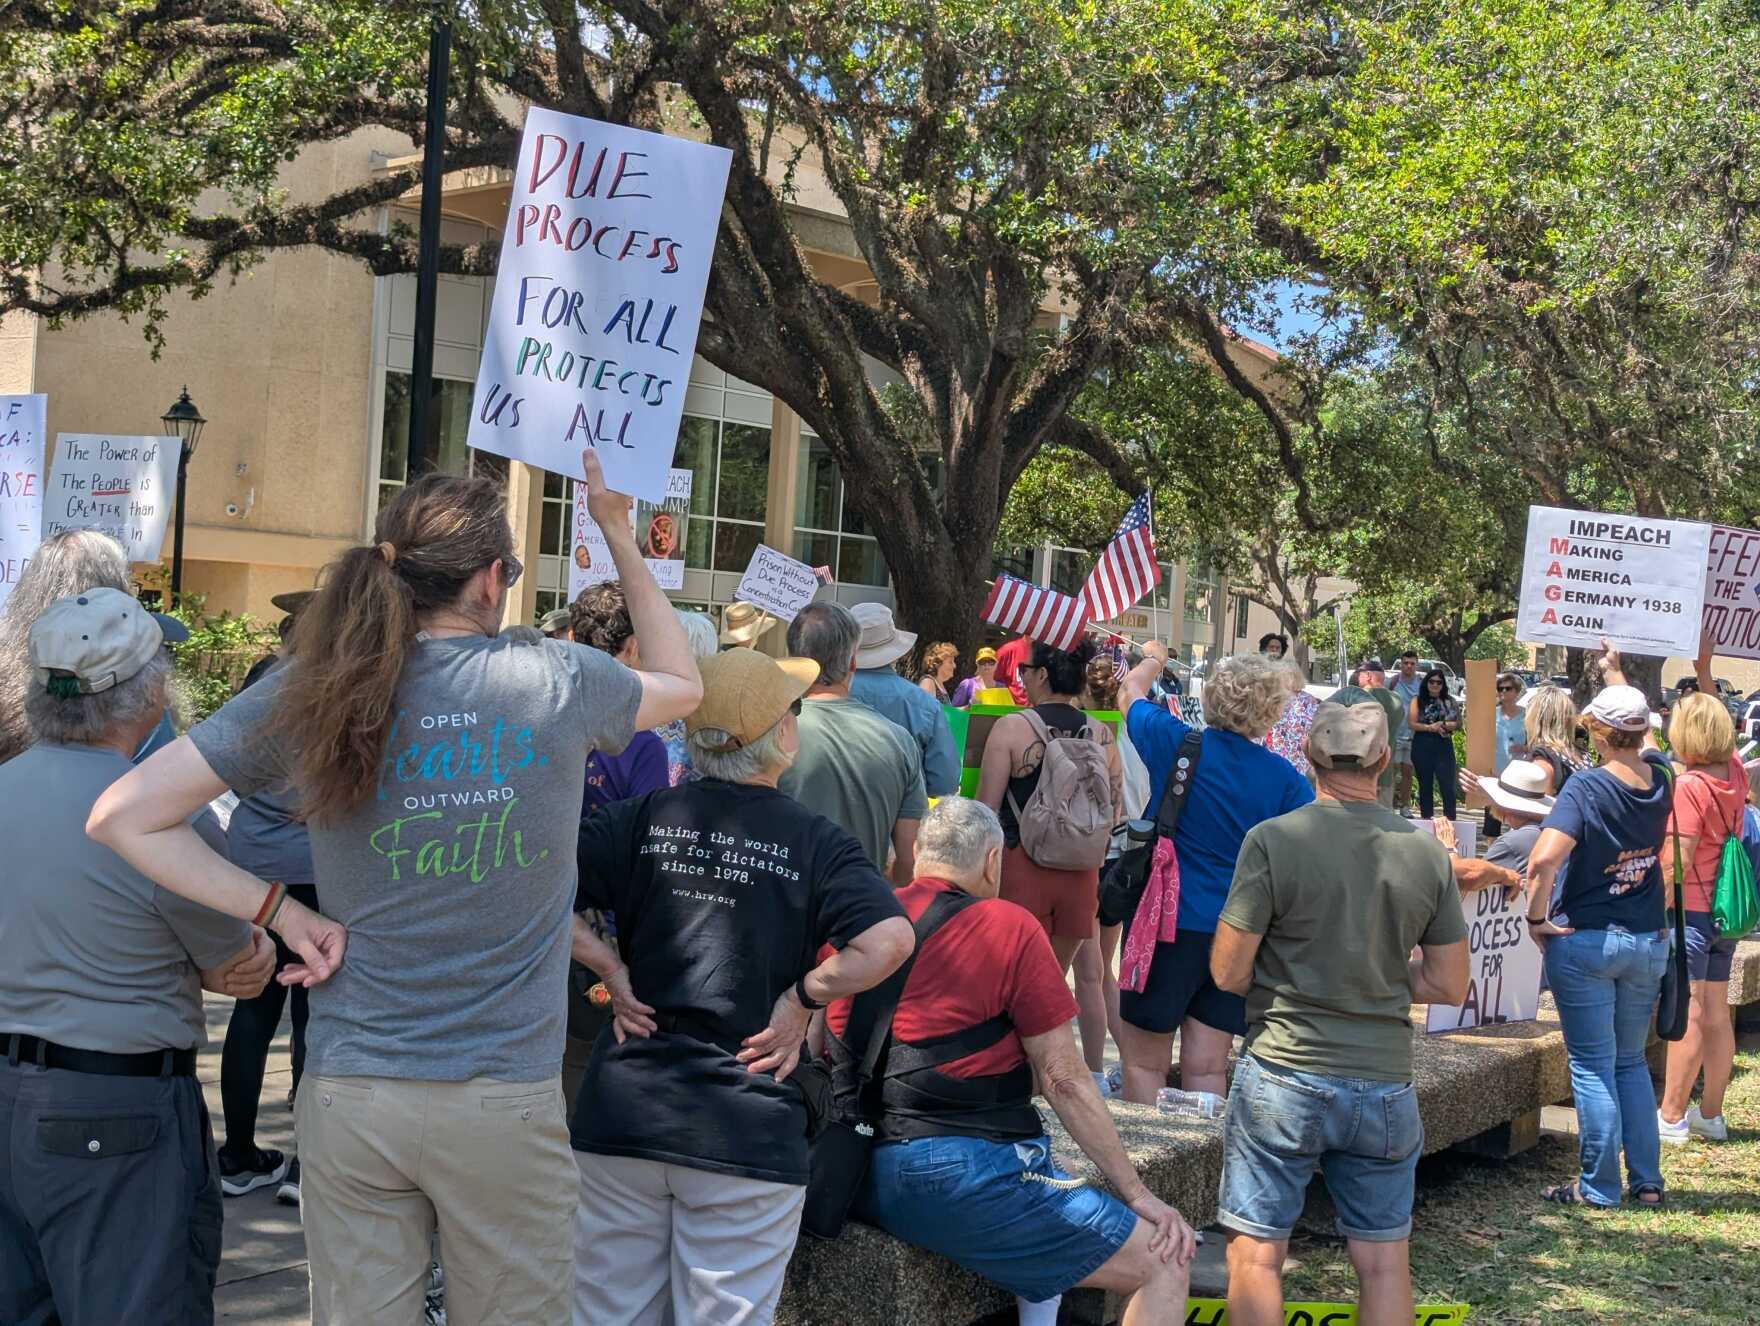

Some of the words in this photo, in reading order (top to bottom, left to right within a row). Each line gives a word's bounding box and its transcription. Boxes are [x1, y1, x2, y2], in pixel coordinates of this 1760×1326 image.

[528, 133, 652, 200] DUE
[515, 203, 682, 274] PROCESS
[515, 276, 588, 336] FOR
[603, 299, 680, 355] ALL
[515, 336, 673, 407] PROTECTS
[480, 383, 525, 428] US
[564, 403, 636, 449] ALL
[65, 440, 89, 461] The
[143, 442, 159, 462] of
[0, 471, 37, 497] RSE
[61, 473, 86, 490] The
[668, 475, 691, 494] ACH
[67, 495, 121, 518] GREATER
[129, 502, 154, 517] than
[1569, 519, 1672, 545] IMPEACH
[1550, 538, 1624, 561] MAKING
[758, 553, 782, 574] Prison
[1546, 560, 1632, 586] AMERICA
[758, 568, 776, 585] Due
[779, 577, 810, 599] Process
[1714, 580, 1745, 600] THE
[1545, 585, 1637, 609] GERMANY
[1642, 598, 1682, 614] 1938
[1541, 607, 1604, 630] AGAIN
[420, 711, 478, 729] OPEN
[404, 787, 515, 809] OUTWARD
[369, 797, 549, 883] Faith.
[649, 825, 701, 842] Making
[710, 831, 736, 845] the
[744, 838, 789, 860] world
[640, 841, 678, 855] nsafe
[687, 844, 714, 859] for
[721, 850, 800, 881] dictators
[661, 860, 705, 875] since
[713, 866, 755, 885] 1978.
[672, 887, 737, 908] www.hrw.org
[1477, 887, 1509, 917] DUE
[1470, 916, 1522, 954] OCESS
[1481, 953, 1503, 979] FOR
[1458, 976, 1507, 1027] ALL
